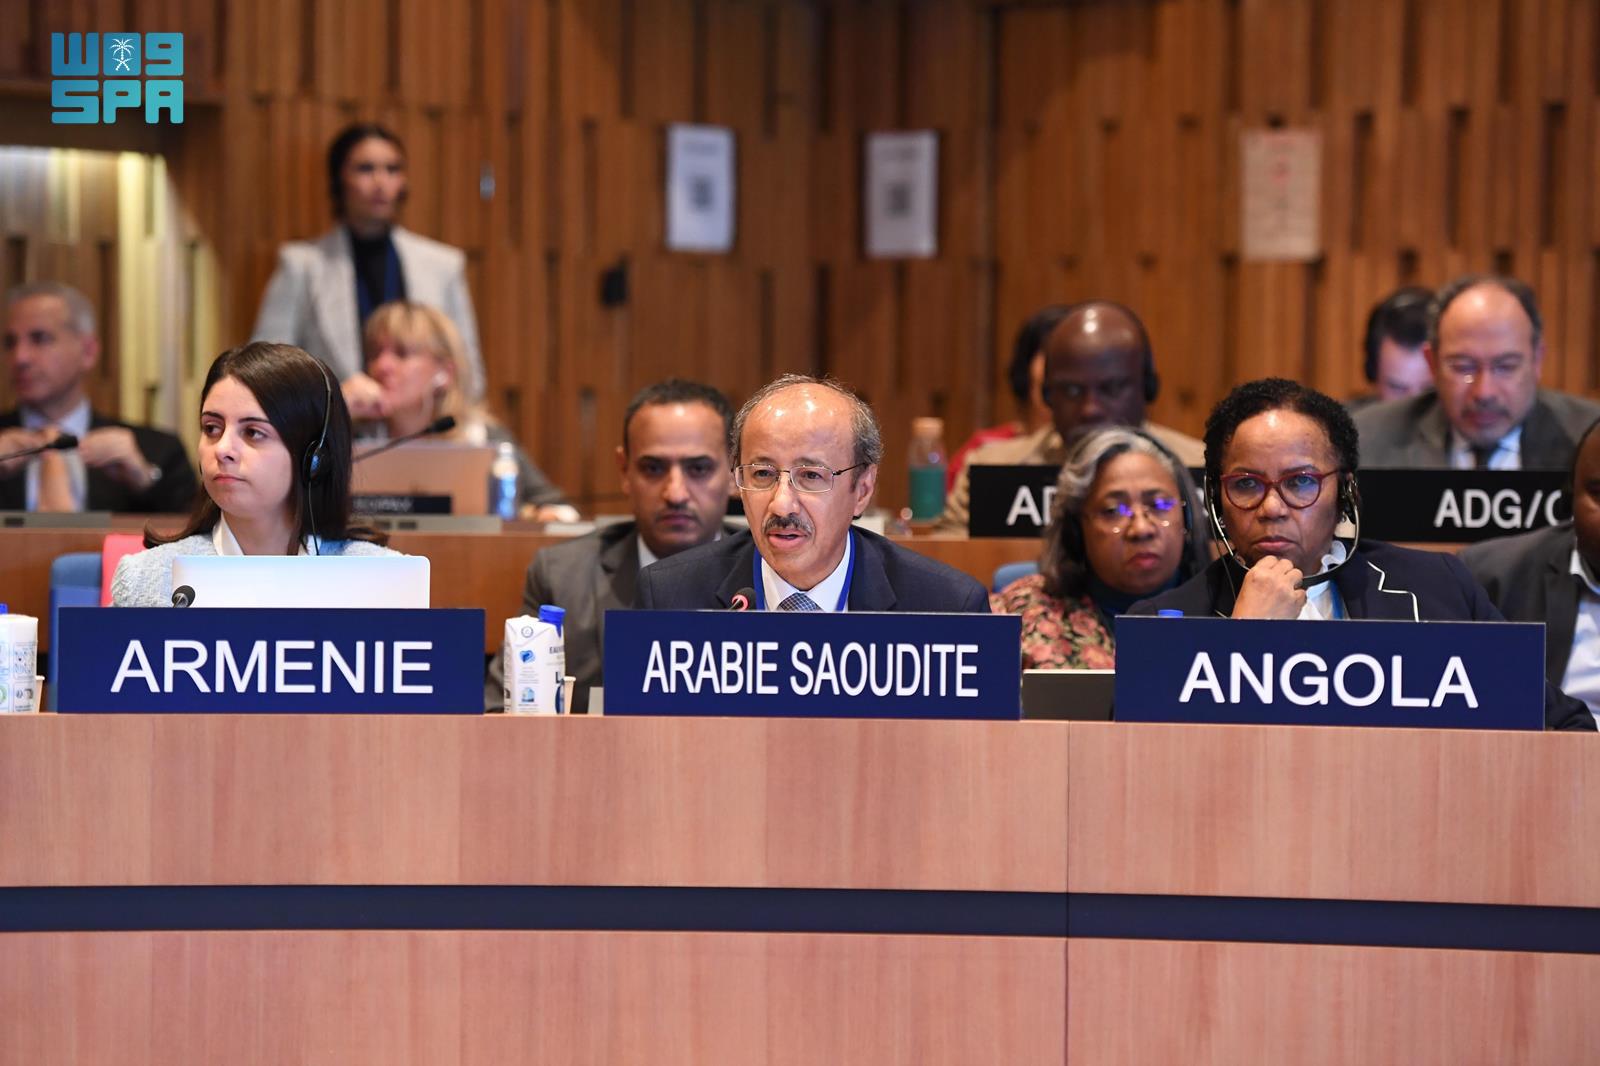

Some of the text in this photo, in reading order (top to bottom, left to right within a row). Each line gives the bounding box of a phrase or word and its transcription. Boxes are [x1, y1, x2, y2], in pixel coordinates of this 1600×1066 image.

[110, 639, 434, 694] ARMENIE
[642, 640, 979, 697] ARABIE SAOUDITE
[1178, 651, 1479, 709] ANGOLA
